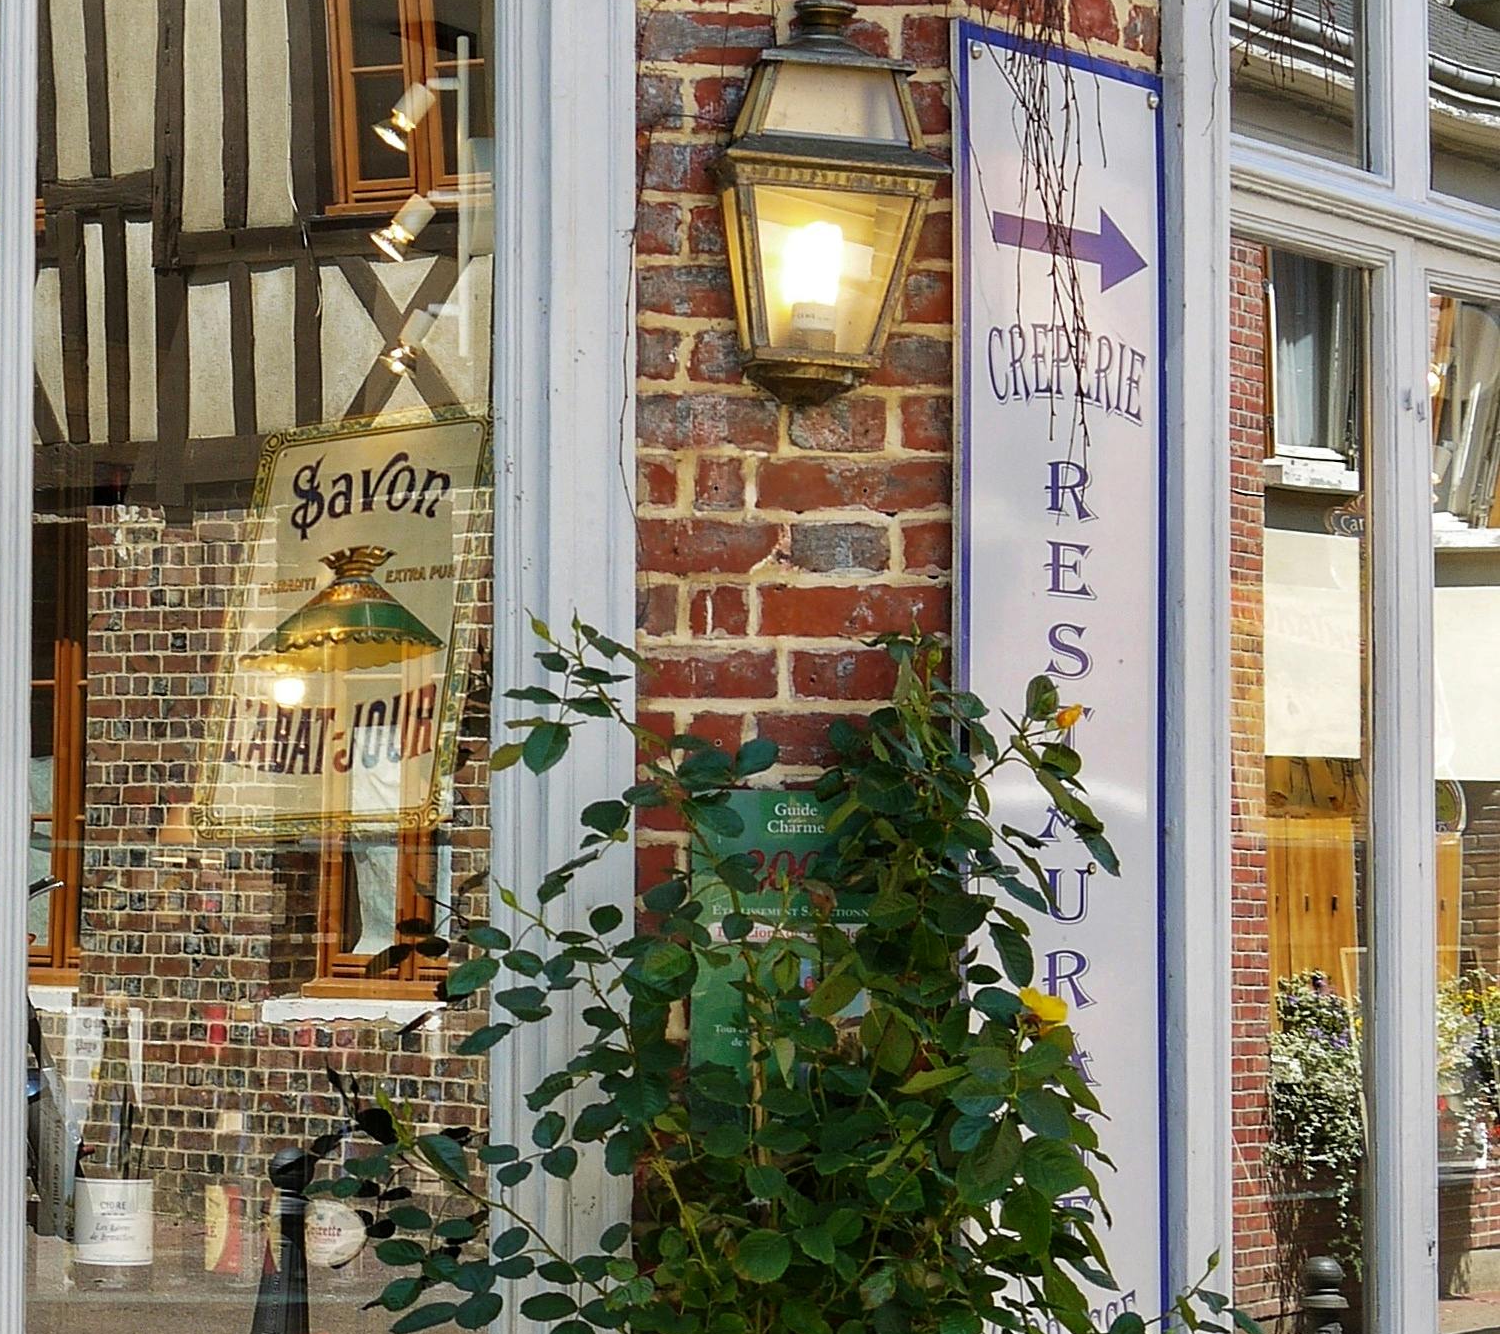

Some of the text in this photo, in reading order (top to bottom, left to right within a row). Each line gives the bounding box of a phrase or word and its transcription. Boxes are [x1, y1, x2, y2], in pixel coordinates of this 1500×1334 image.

[987, 323, 1147, 427] CREPERIE
[291, 449, 451, 540] Savon
[385, 567, 424, 584] EXTRA
[774, 802, 819, 817] Guide
[766, 819, 826, 834] Charme
